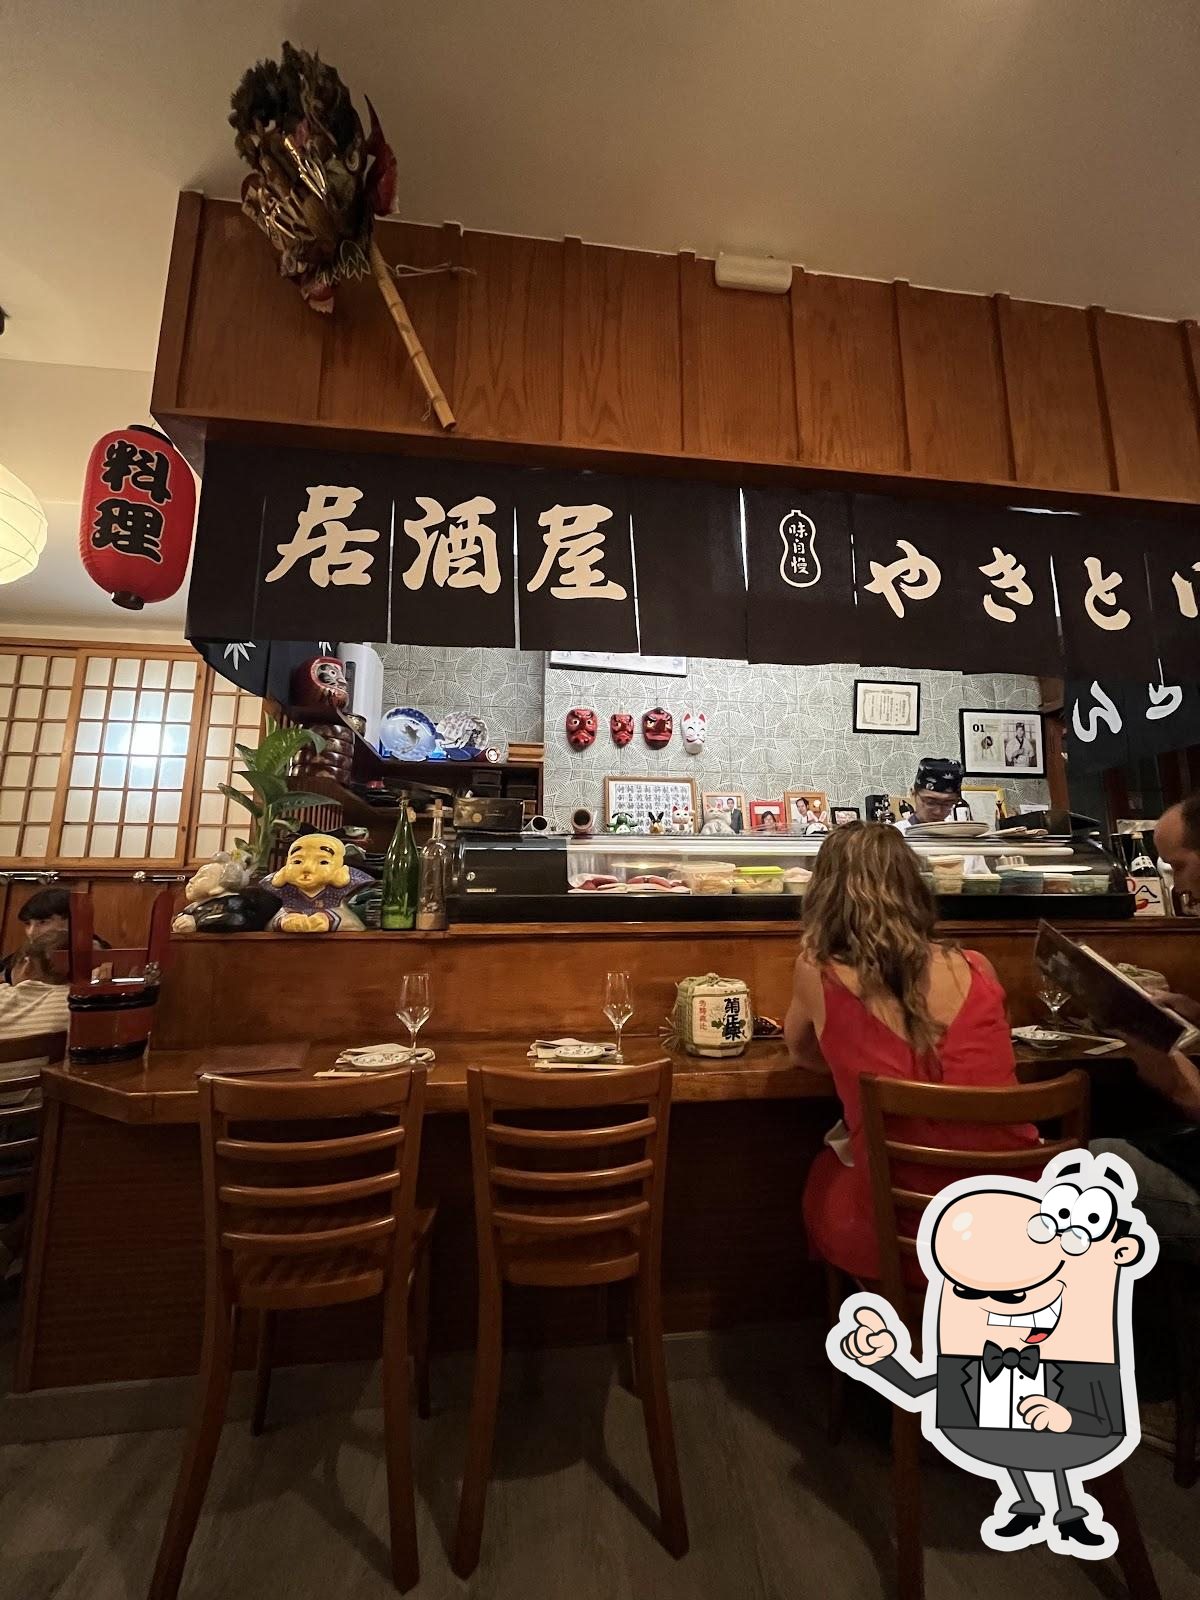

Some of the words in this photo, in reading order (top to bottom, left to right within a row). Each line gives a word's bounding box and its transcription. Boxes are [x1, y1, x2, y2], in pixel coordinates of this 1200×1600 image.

[91, 439, 173, 565] 料理
[264, 485, 628, 602] 居酒屋
[788, 521, 810, 575] 味自慢
[972, 723, 985, 733] 01
